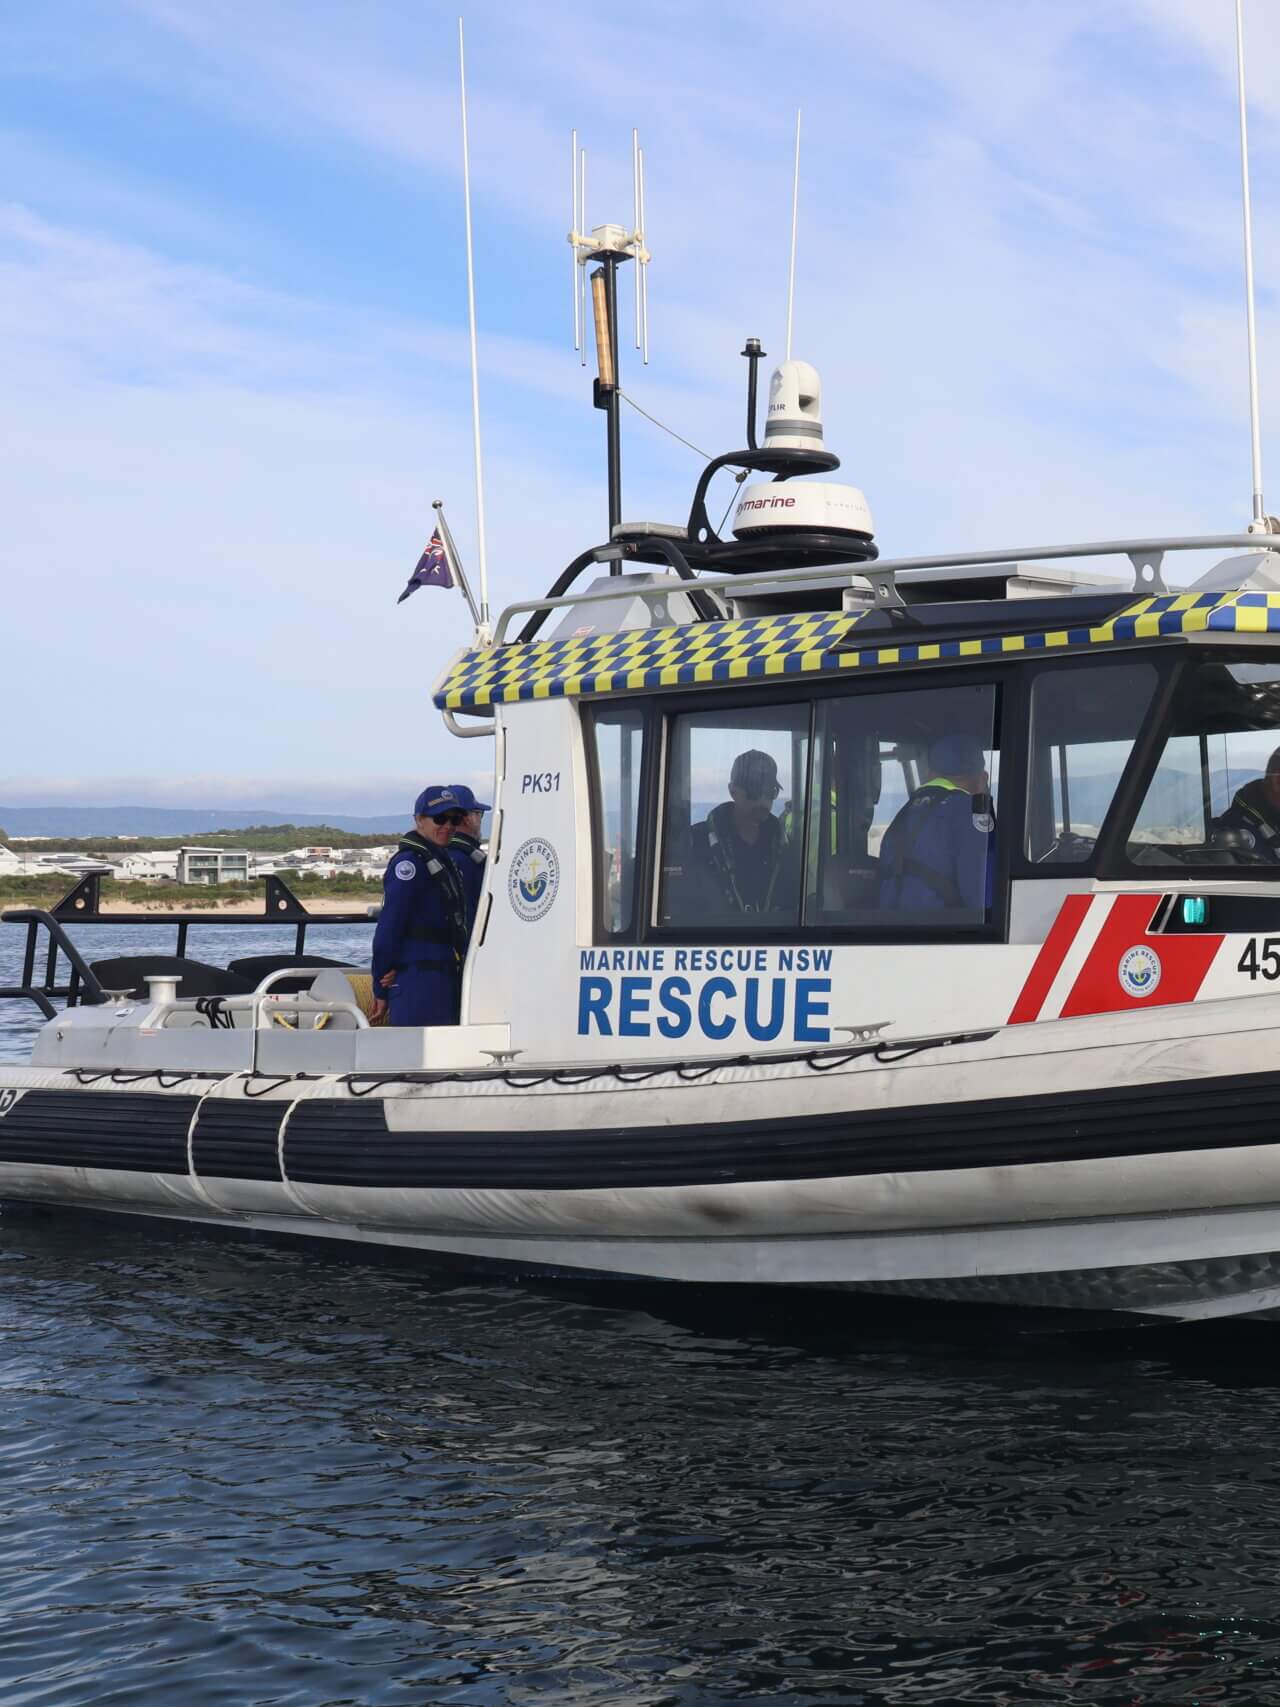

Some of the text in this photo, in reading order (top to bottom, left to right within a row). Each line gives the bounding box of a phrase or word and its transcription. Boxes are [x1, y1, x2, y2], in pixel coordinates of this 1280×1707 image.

[522, 772, 560, 794] PK31
[513, 845, 555, 888] MARINE RESCUE
[580, 949, 832, 971] MARINE RESCUE NSW
[577, 976, 832, 1042] RESCUE
